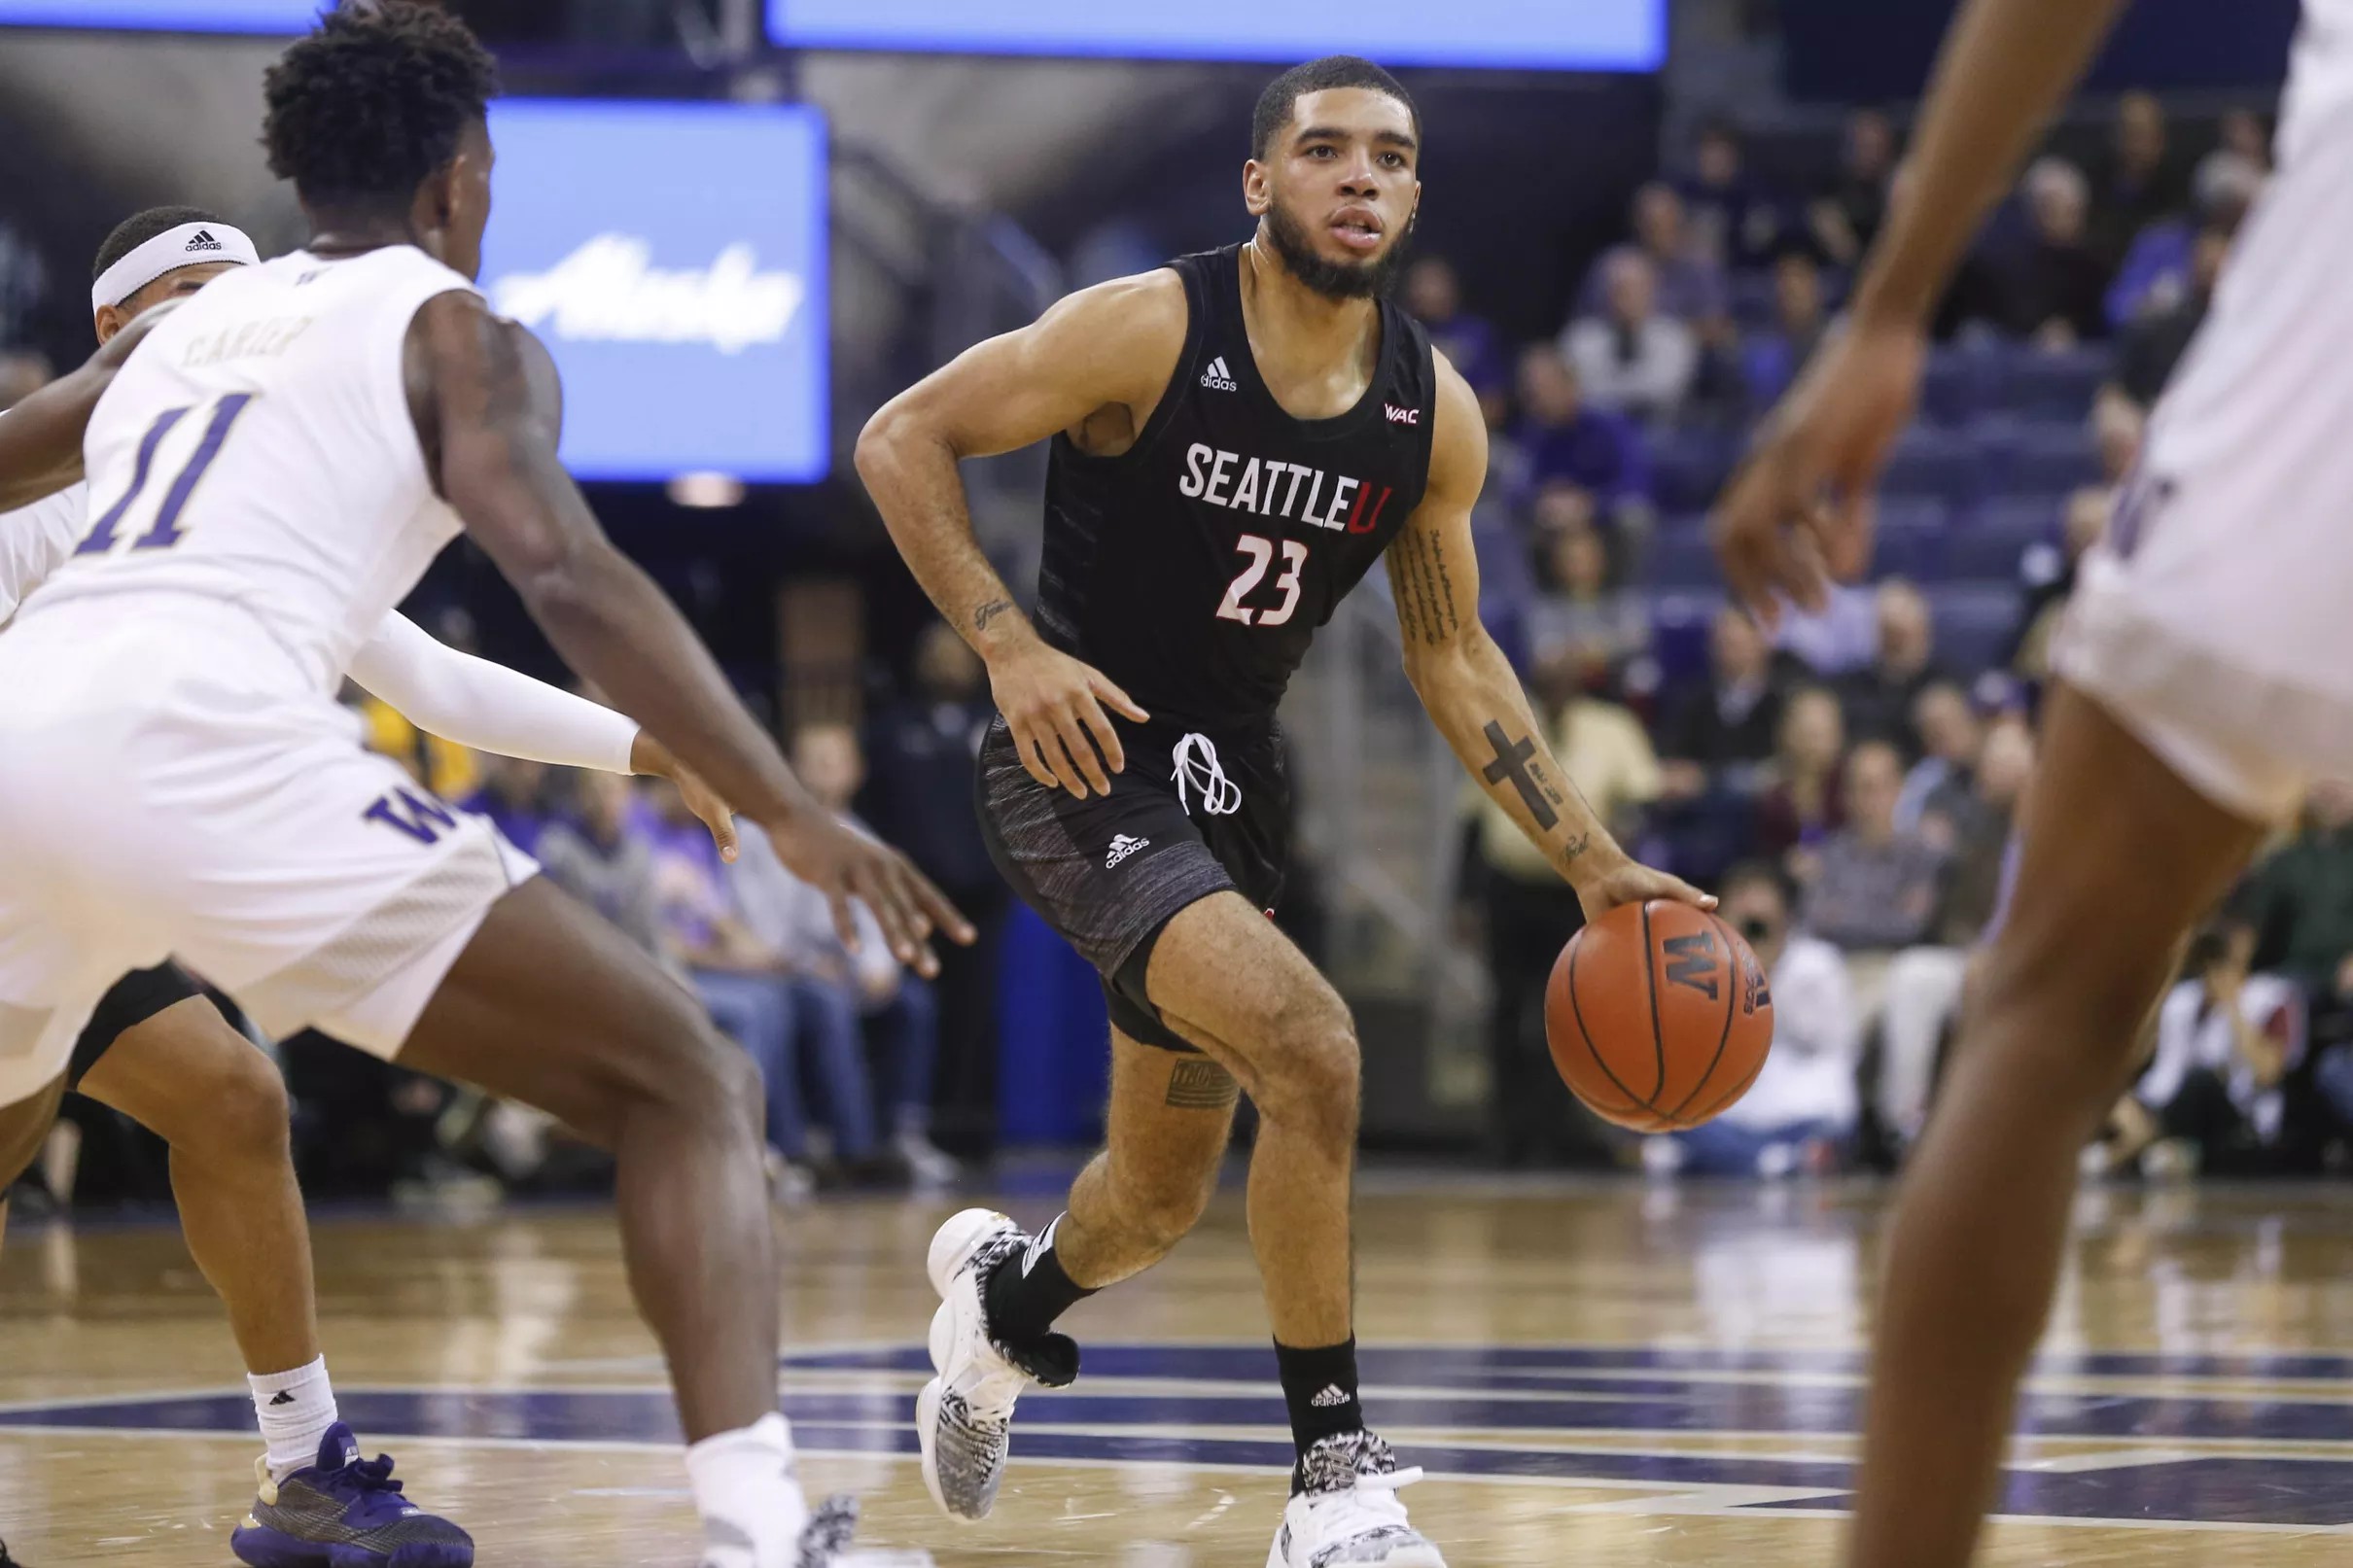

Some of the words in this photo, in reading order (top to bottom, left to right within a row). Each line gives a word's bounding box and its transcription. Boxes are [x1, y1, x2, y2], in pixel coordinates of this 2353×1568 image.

[185, 242, 222, 252] adidas
[1384, 401, 1420, 425] WAC
[73, 391, 260, 556] 11
[1214, 533, 1309, 626] 23
[361, 786, 457, 845] W
[1106, 837, 1150, 869] adidas
[1663, 930, 1718, 1001] W
[1312, 1392, 1351, 1407] adidas
